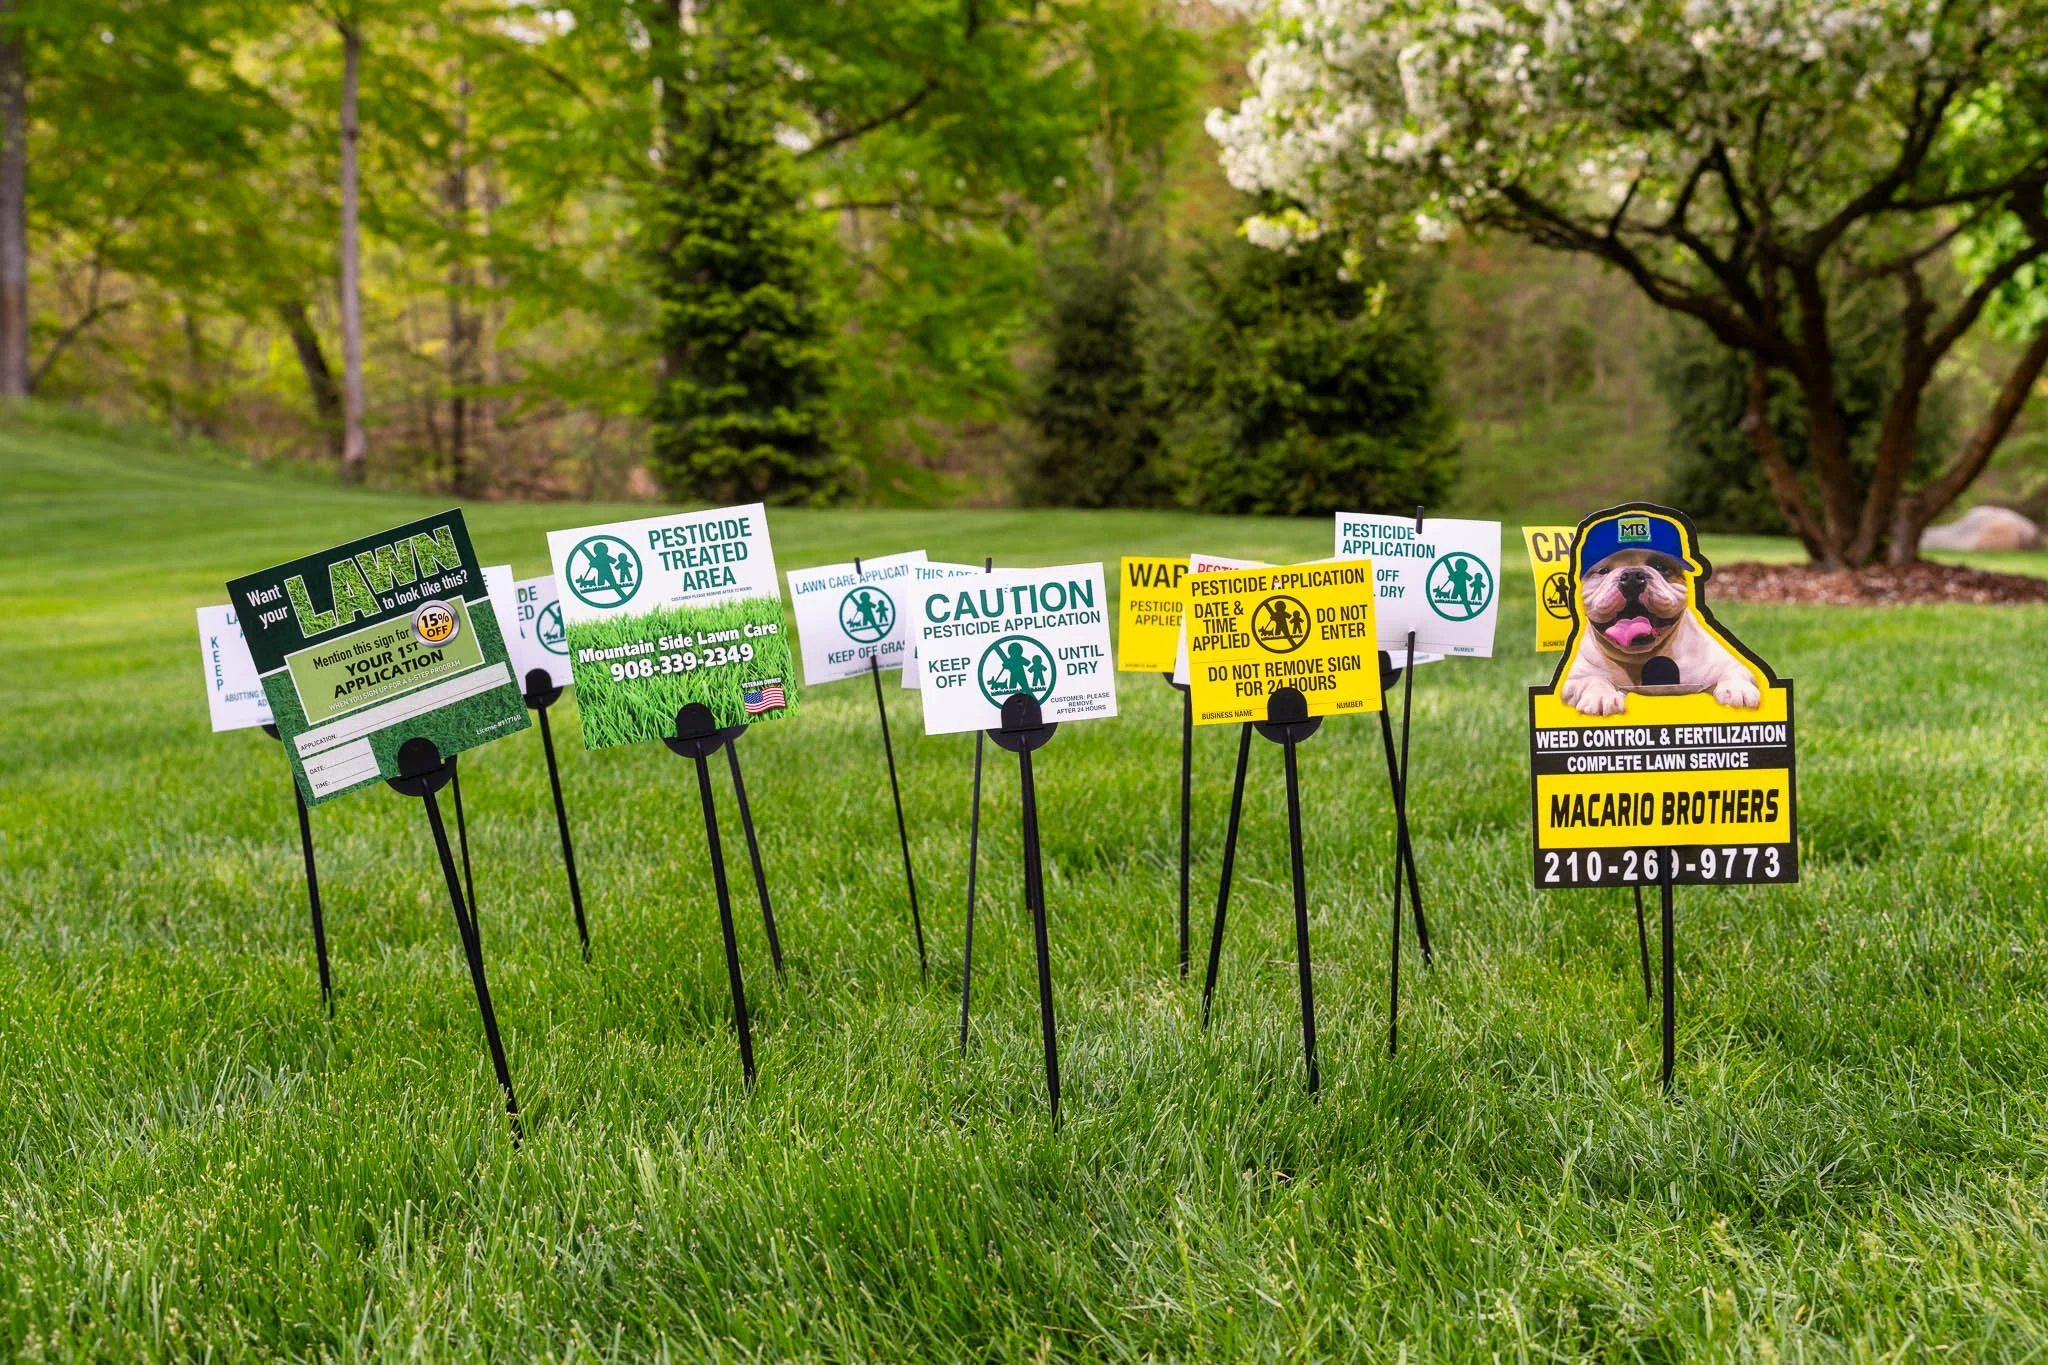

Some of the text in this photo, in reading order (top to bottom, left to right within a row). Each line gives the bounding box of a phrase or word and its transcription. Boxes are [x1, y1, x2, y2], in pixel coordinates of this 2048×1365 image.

[648, 517, 752, 550] PESTICIDE
[1343, 523, 1415, 540] PESTICIDE
[658, 541, 748, 571] TREATED
[1342, 540, 1436, 558] APPLICATION
[284, 525, 461, 638] LAWN
[683, 566, 737, 592] AREA
[914, 568, 944, 580] THIS
[1192, 568, 1364, 596] PESTICIDE APPLICATION
[1377, 569, 1400, 582] OFF
[382, 597, 394, 610] to
[397, 587, 420, 606] look
[421, 582, 441, 600] like
[443, 569, 469, 589] this?
[796, 579, 826, 594] LAWN
[828, 574, 857, 589] CARE
[1380, 585, 1405, 598] DRY
[246, 585, 282, 607] Want
[925, 579, 1094, 624] CAUTION
[259, 606, 288, 629] your
[1194, 600, 1244, 618] DATE &
[1316, 604, 1368, 623] DO NOT
[422, 613, 449, 628] 15%
[924, 610, 1101, 640] PESTICIDE APPLICATION
[1203, 618, 1238, 634] TIME
[426, 625, 448, 638] OFF
[1321, 622, 1366, 640] ENTER
[313, 628, 410, 670] Mention this sign for
[578, 624, 778, 663] Mountain Side Lawn Care
[1192, 632, 1250, 652] APPLIED
[345, 641, 420, 676] YOUR 1ST
[828, 649, 854, 664] KEEP
[858, 645, 878, 659] OFF
[1058, 644, 1104, 660] UNTIL
[610, 643, 754, 682] 908-339-2349
[928, 657, 971, 673] KEEP
[1066, 661, 1098, 676] DRY
[1208, 655, 1361, 682] DO NOT REMOVE SIGN
[334, 649, 444, 698] APPLICATION
[936, 674, 967, 688] OFF
[328, 699, 349, 711] WHEN
[350, 694, 363, 704] YOU
[364, 690, 379, 701] SIGN
[388, 682, 401, 690] FOR
[431, 660, 460, 674] PROGRAM
[742, 680, 763, 688] VETERAN
[1236, 680, 1263, 697] FOR
[1050, 692, 1110, 704] CUSTOMER: PLEASE
[1068, 700, 1094, 708] REMOVE
[1336, 700, 1363, 710] NUMBER
[1056, 707, 1076, 715] AFTER
[1086, 704, 1106, 712] HOURS
[1202, 710, 1254, 720] BUSINESS NAME
[1536, 724, 1786, 749] WEED CONTROL & FERTILIZATION
[1567, 752, 1748, 773] COMPLETE LAWN SERVICE
[1550, 788, 1780, 828] MACARIO BROTHERS
